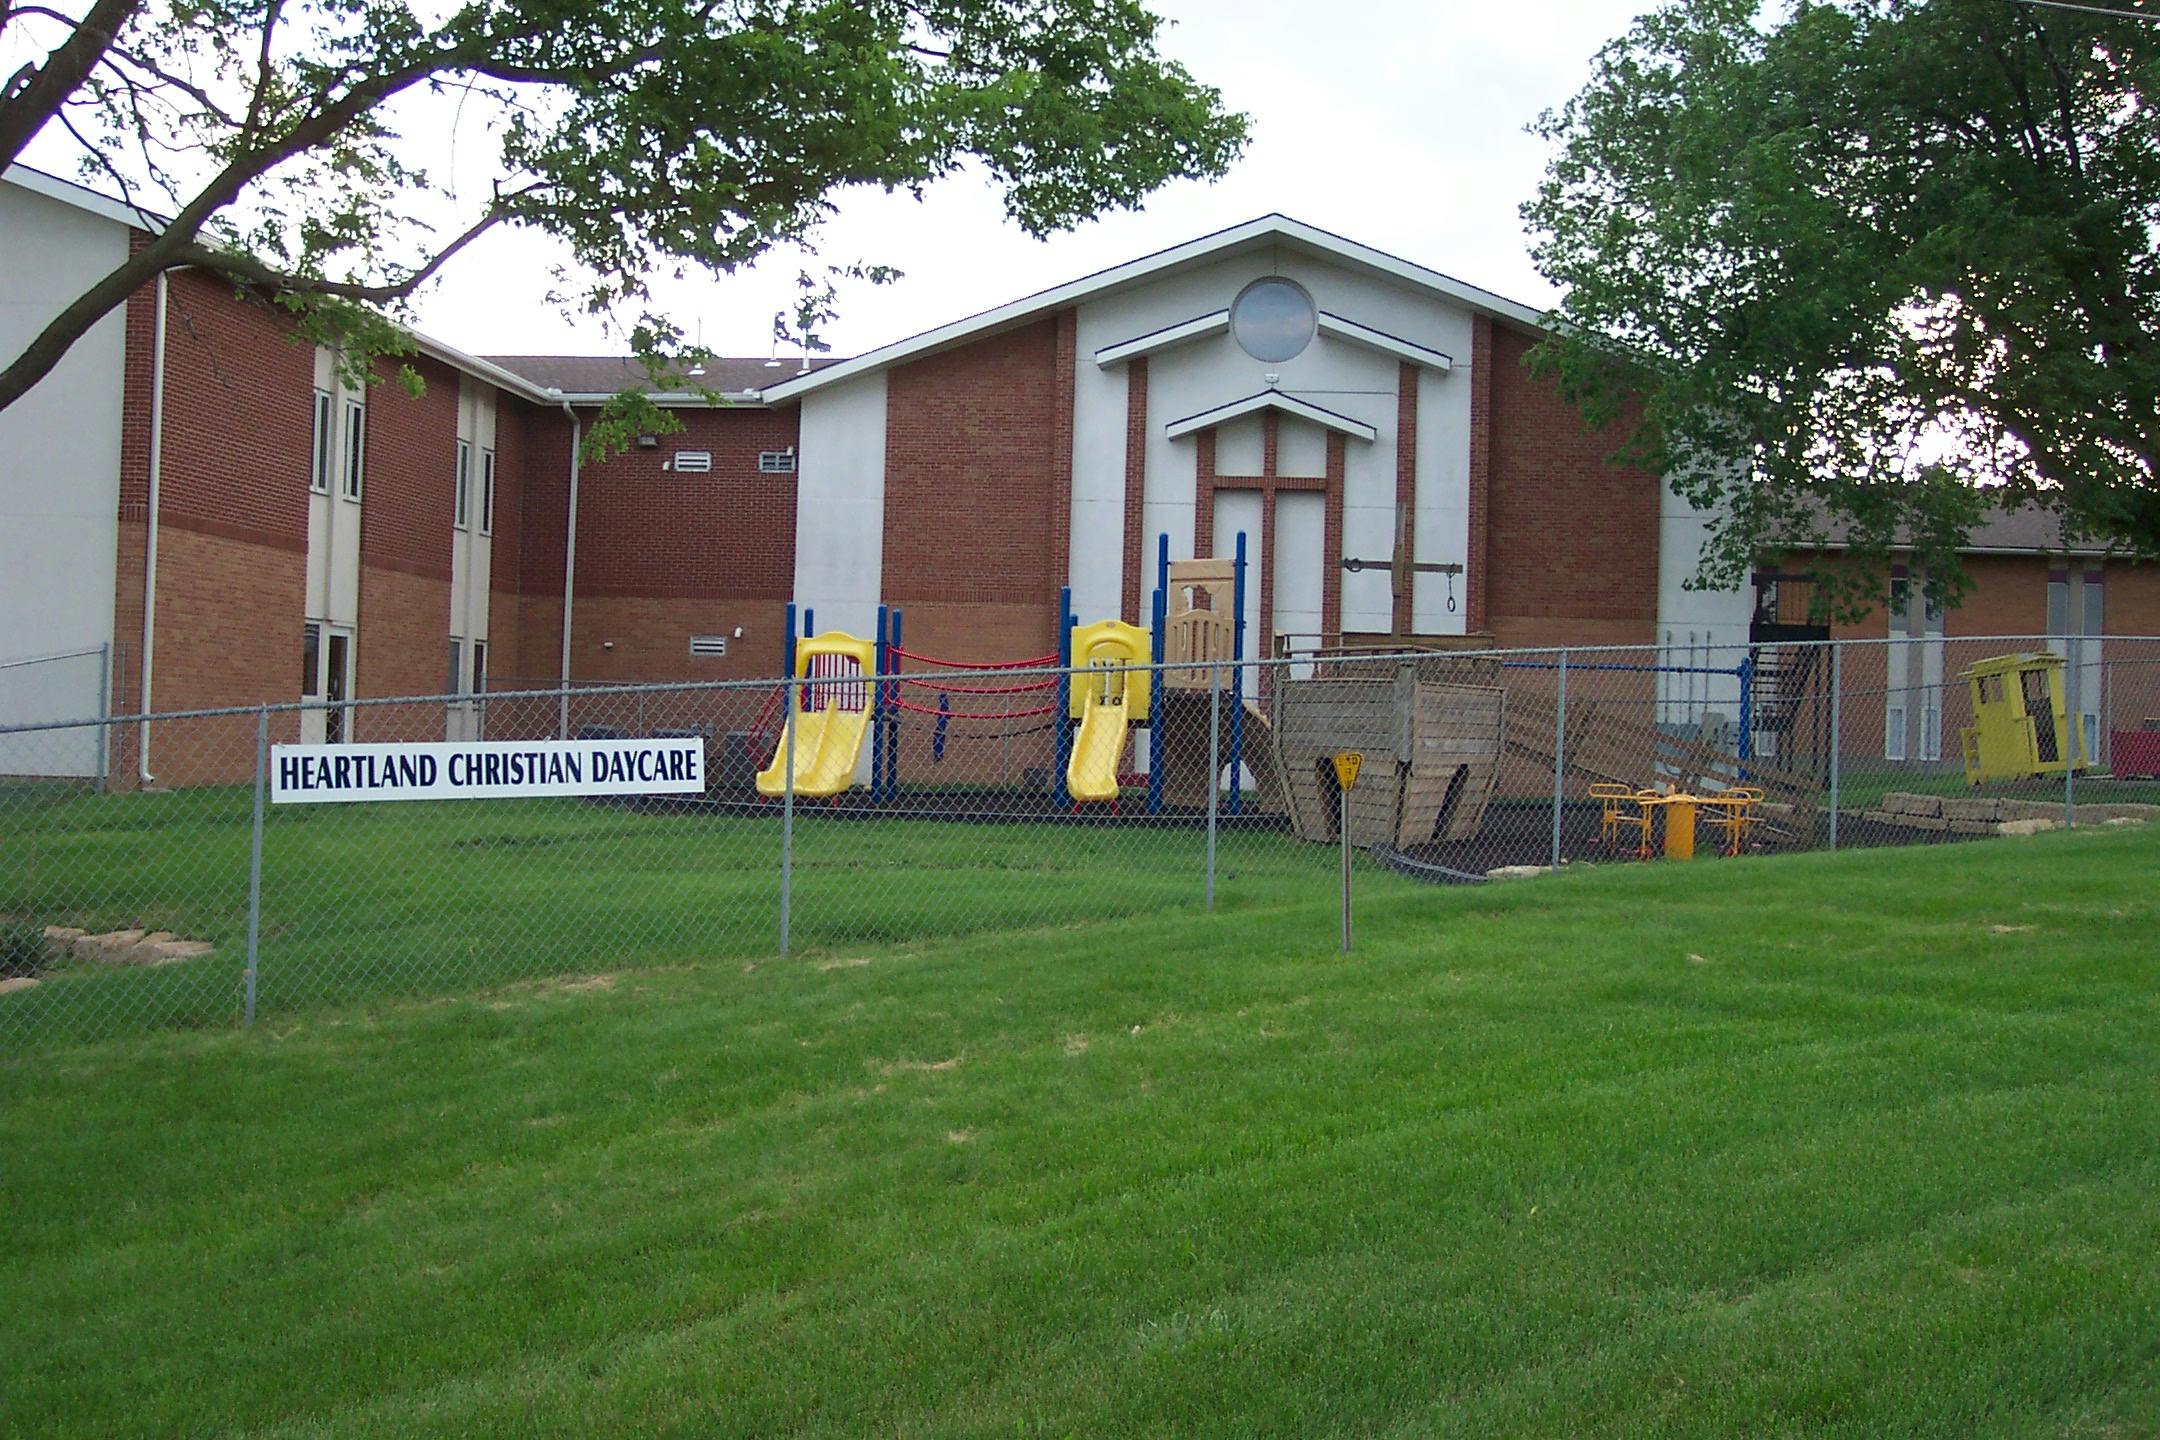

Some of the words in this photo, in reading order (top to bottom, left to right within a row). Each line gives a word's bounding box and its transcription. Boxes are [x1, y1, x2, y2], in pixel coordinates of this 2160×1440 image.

[280, 755, 437, 790] HEARTLAND
[448, 751, 582, 786] CHRISTIAN
[592, 749, 698, 782] DAYCARE
